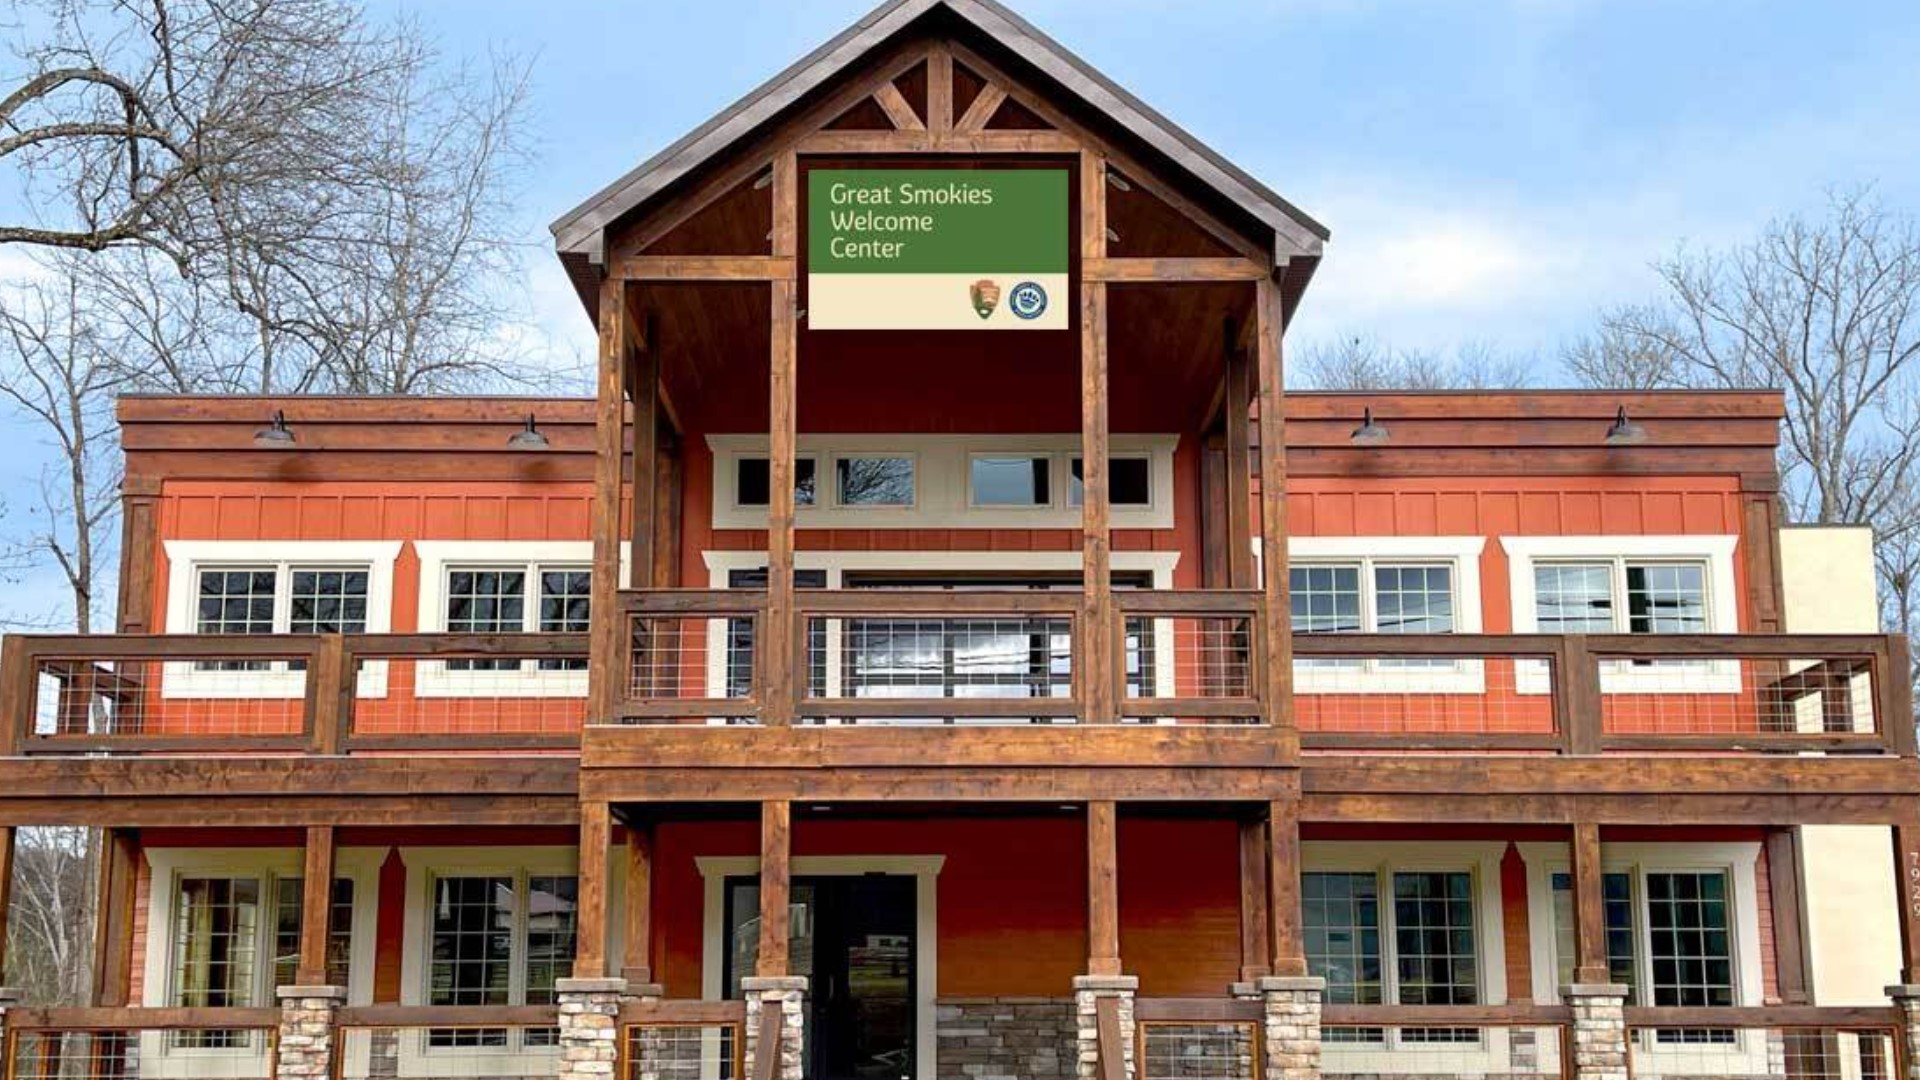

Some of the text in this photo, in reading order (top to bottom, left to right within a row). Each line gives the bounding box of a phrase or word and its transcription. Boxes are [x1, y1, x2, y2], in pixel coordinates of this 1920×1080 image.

[830, 182, 993, 205] Great Smokies
[830, 210, 933, 232] Welcome
[830, 237, 904, 259] Center
